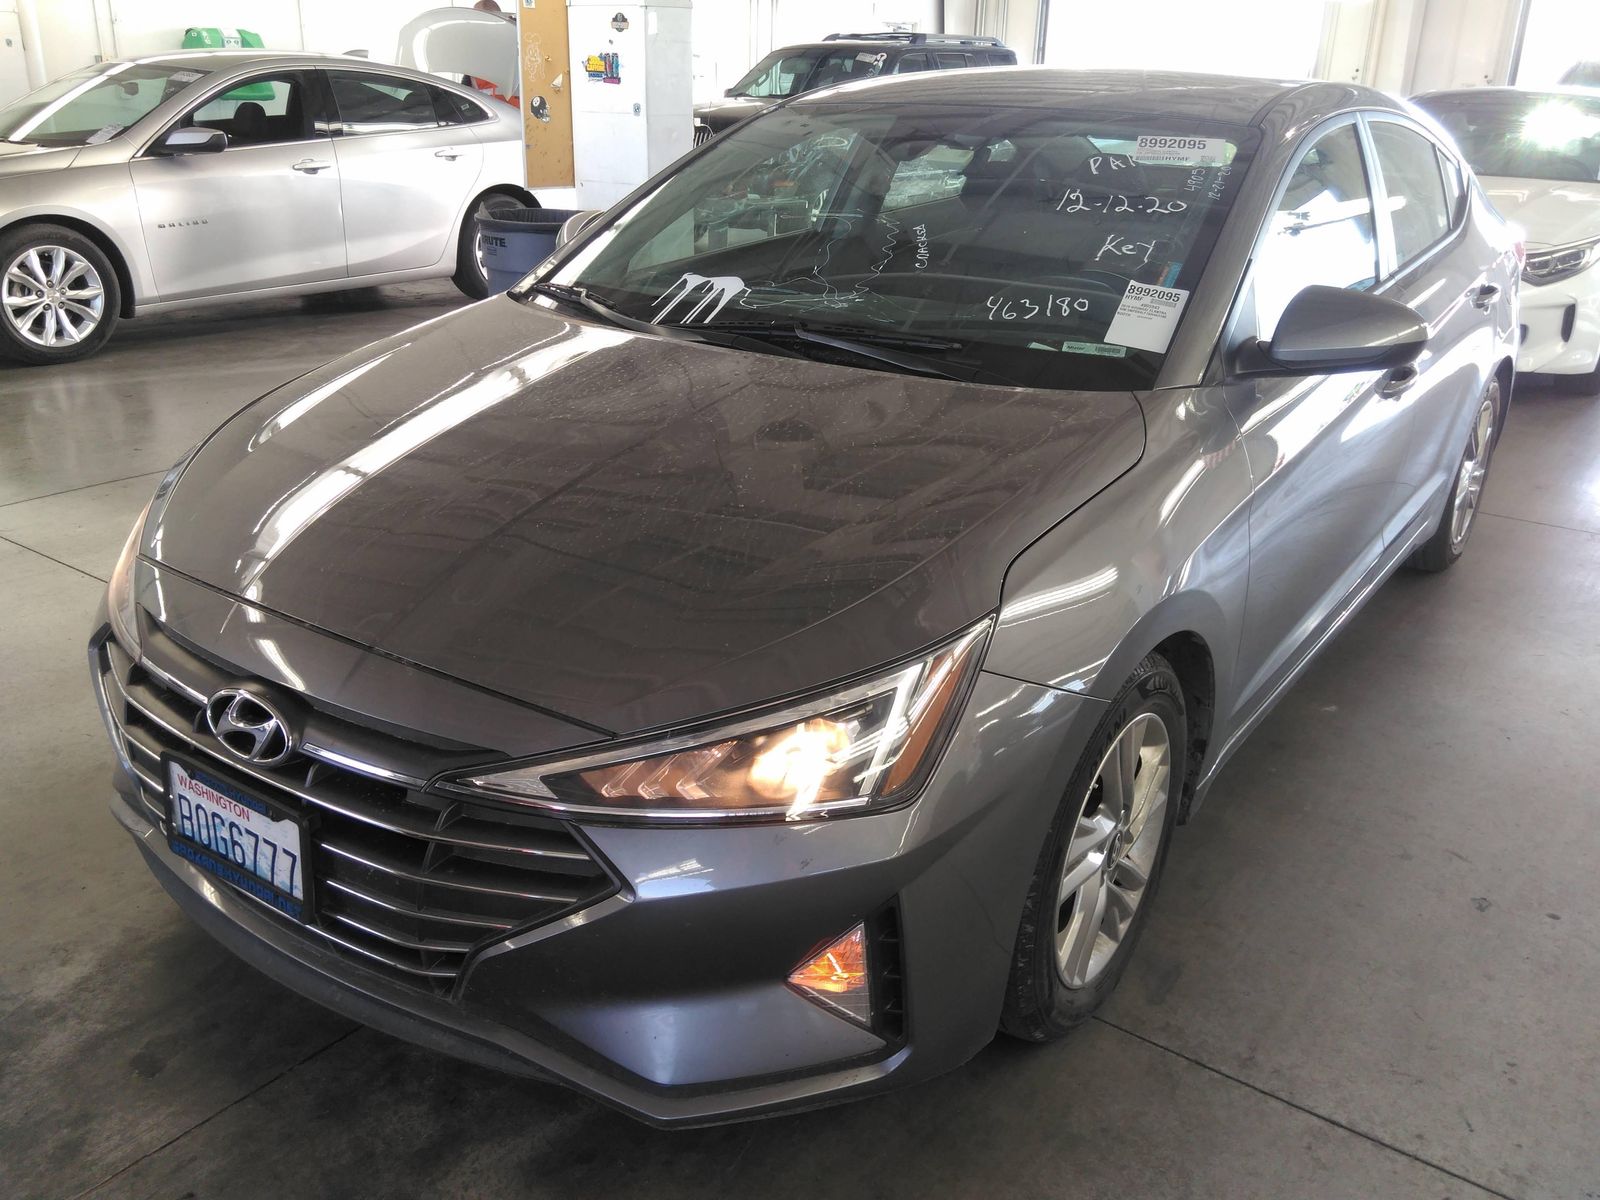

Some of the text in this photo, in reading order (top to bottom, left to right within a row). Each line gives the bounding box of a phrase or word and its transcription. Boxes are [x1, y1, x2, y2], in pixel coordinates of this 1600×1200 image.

[1138, 137, 1207, 150] 8992095
[1127, 284, 1181, 303] 8992095
[177, 773, 250, 822] WASHINGTON
